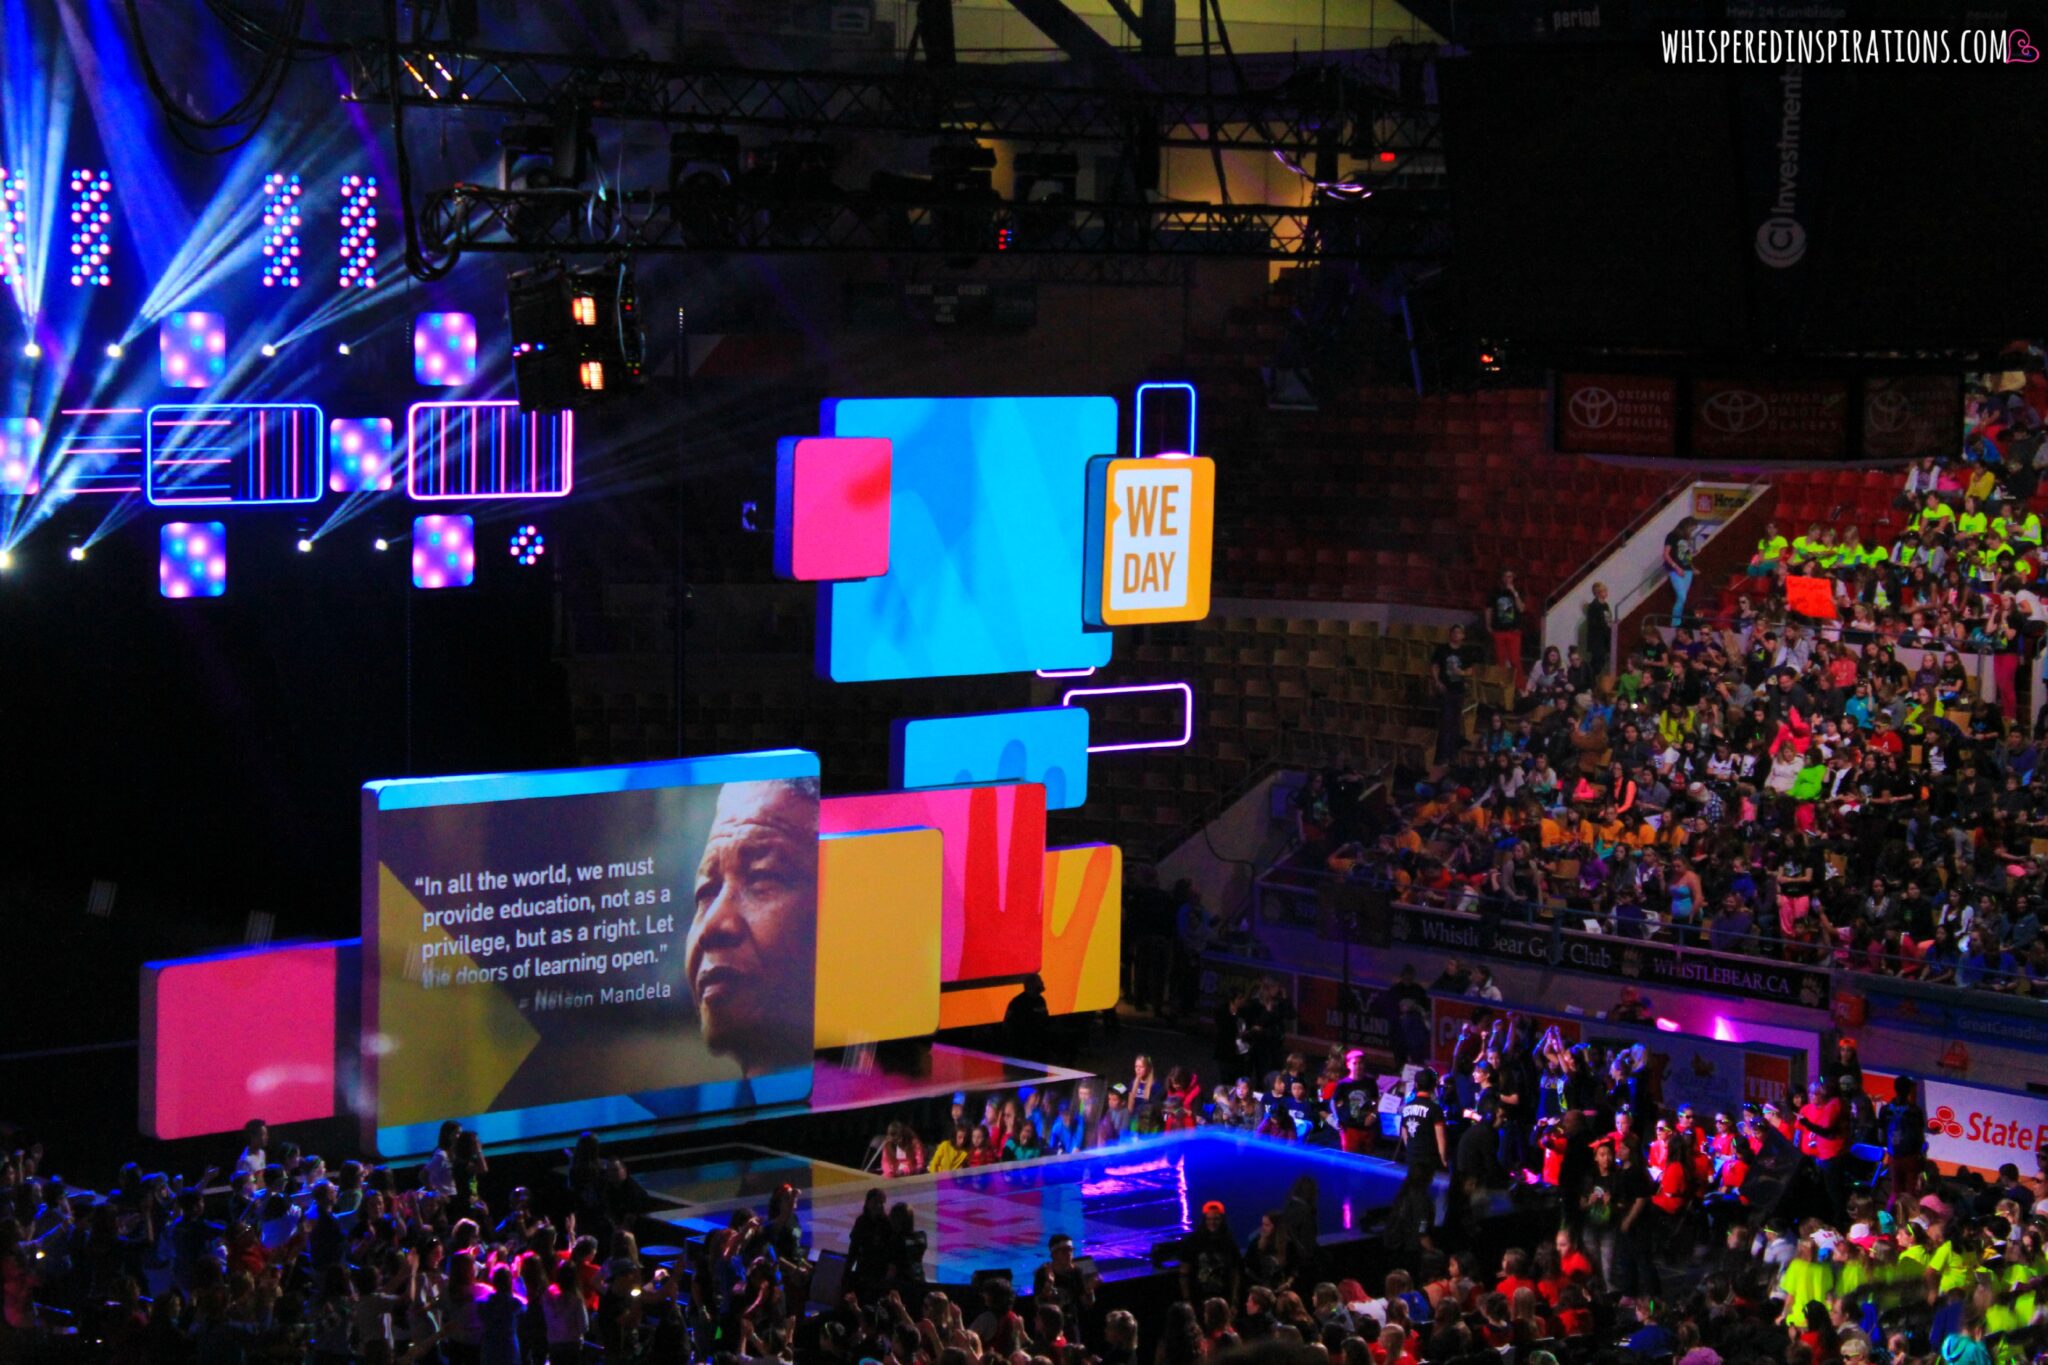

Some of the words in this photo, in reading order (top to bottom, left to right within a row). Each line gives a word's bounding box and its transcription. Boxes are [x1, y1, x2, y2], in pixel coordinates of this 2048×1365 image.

[1552, 4, 1600, 32] period
[1126, 485, 1179, 537] WE
[1123, 551, 1176, 594] DAY
[448, 873, 472, 894] all
[478, 870, 508, 891] the
[512, 864, 571, 887] world,
[577, 864, 603, 881] we
[608, 857, 654, 878] must
[423, 902, 495, 932] provide
[499, 893, 596, 920] education,
[601, 889, 630, 909] not
[634, 887, 655, 905] as
[660, 888, 671, 903] a
[422, 935, 510, 963] privilege,
[515, 927, 546, 948] but
[551, 927, 573, 945] as
[577, 926, 589, 942] a
[593, 919, 641, 943] right.
[646, 914, 674, 934] Let
[1569, 943, 1612, 969] Club
[456, 963, 508, 985] doors
[512, 959, 530, 979] of
[535, 952, 607, 977] learning
[600, 982, 671, 1005] Mandela
